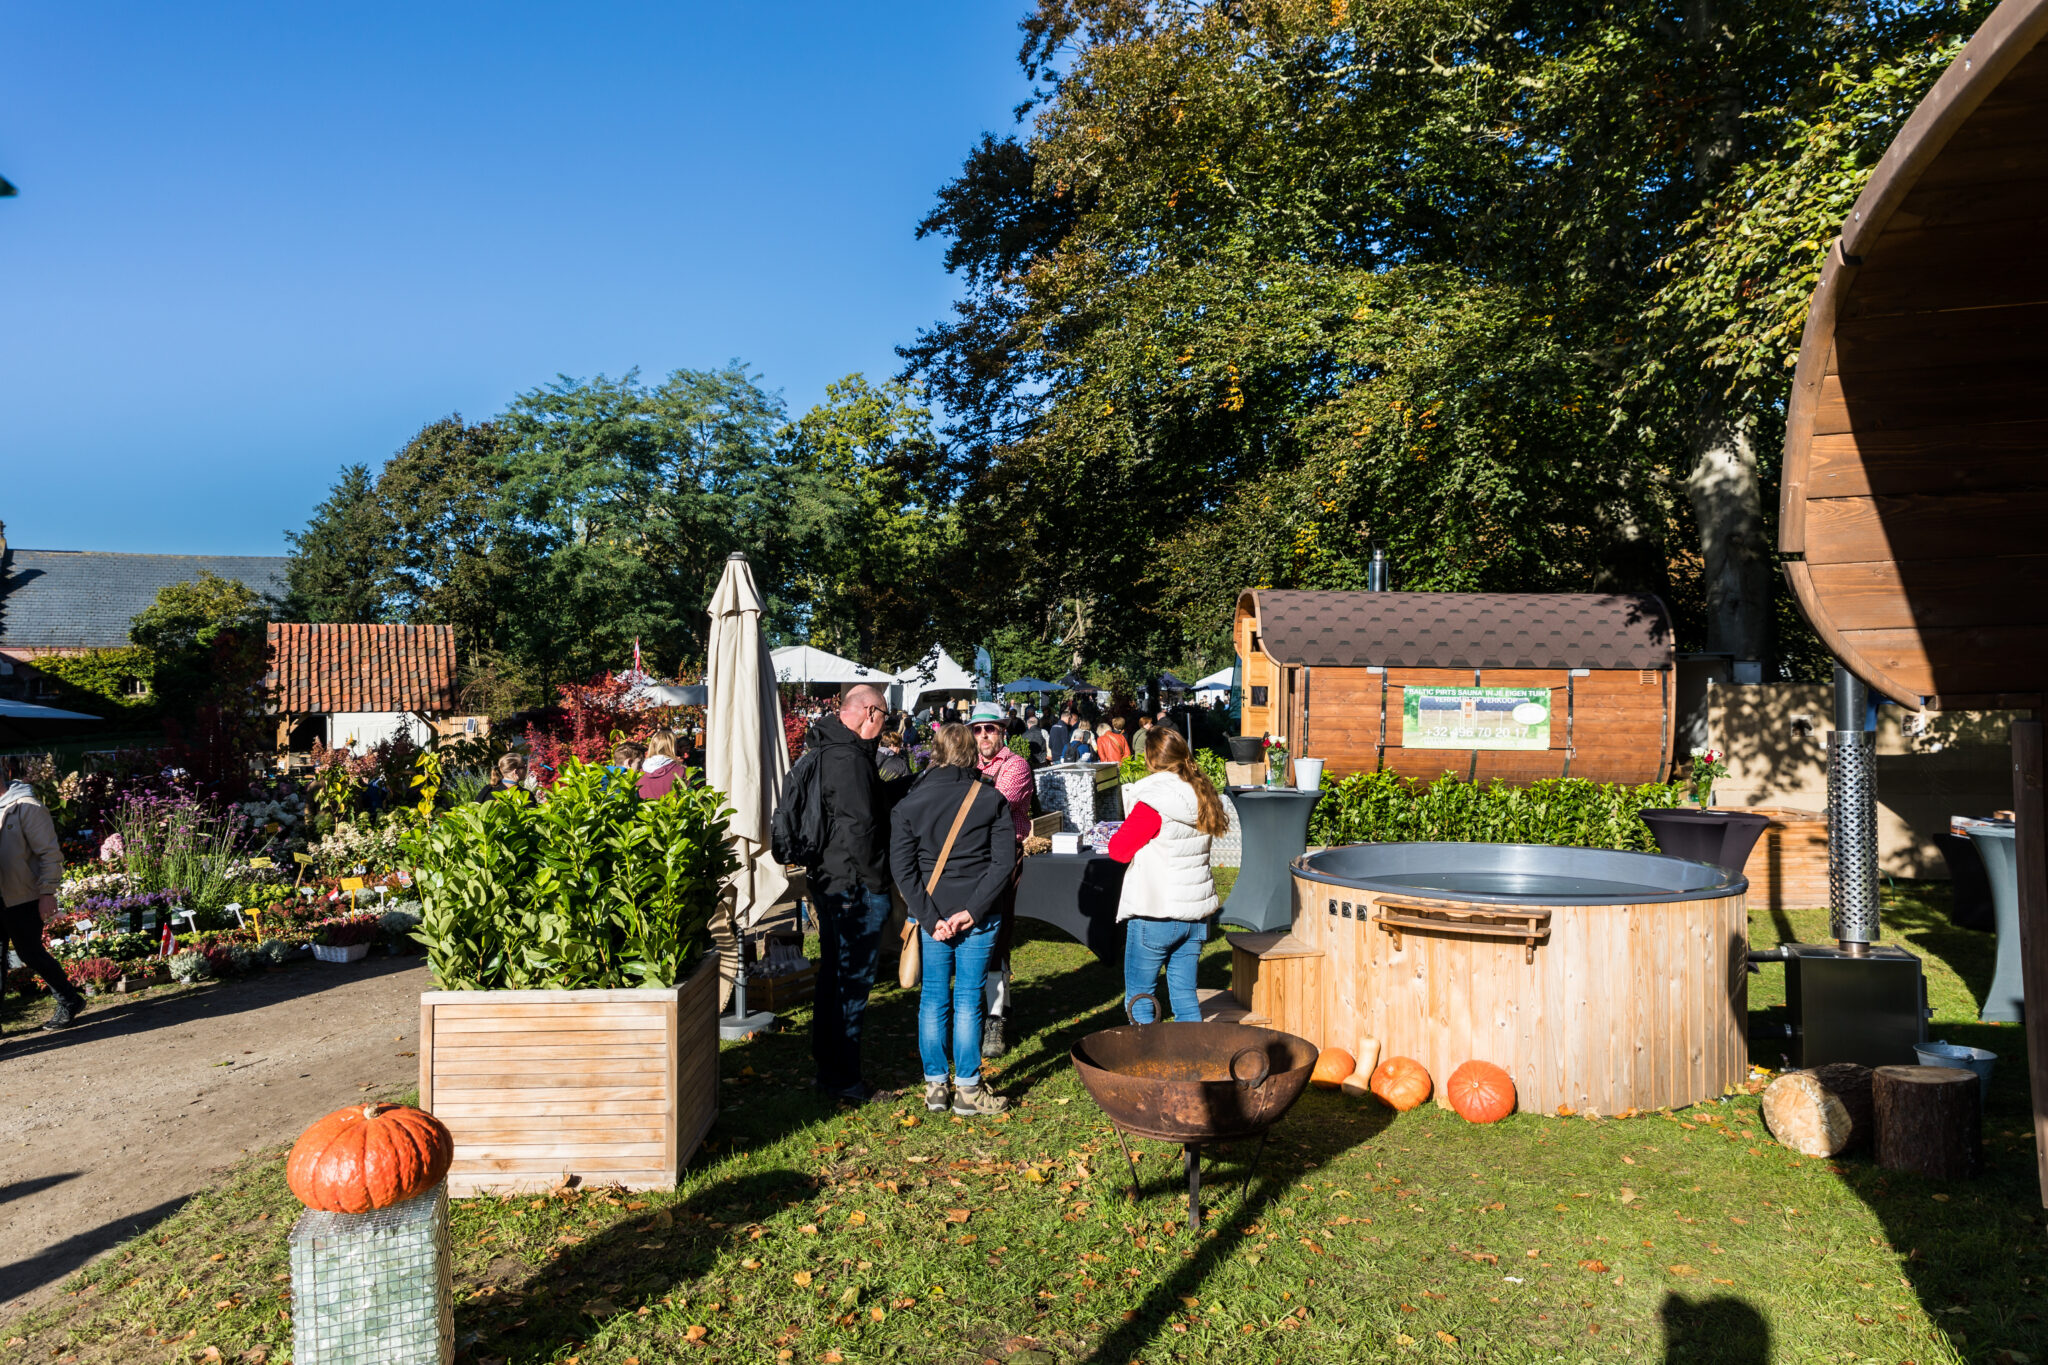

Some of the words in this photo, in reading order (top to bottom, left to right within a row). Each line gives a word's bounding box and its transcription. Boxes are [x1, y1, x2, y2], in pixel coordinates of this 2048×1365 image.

[1426, 726, 1448, 737] +32
[1478, 727, 1492, 737] 70
[1496, 727, 1510, 738] 20
[1515, 727, 1529, 738] 17
